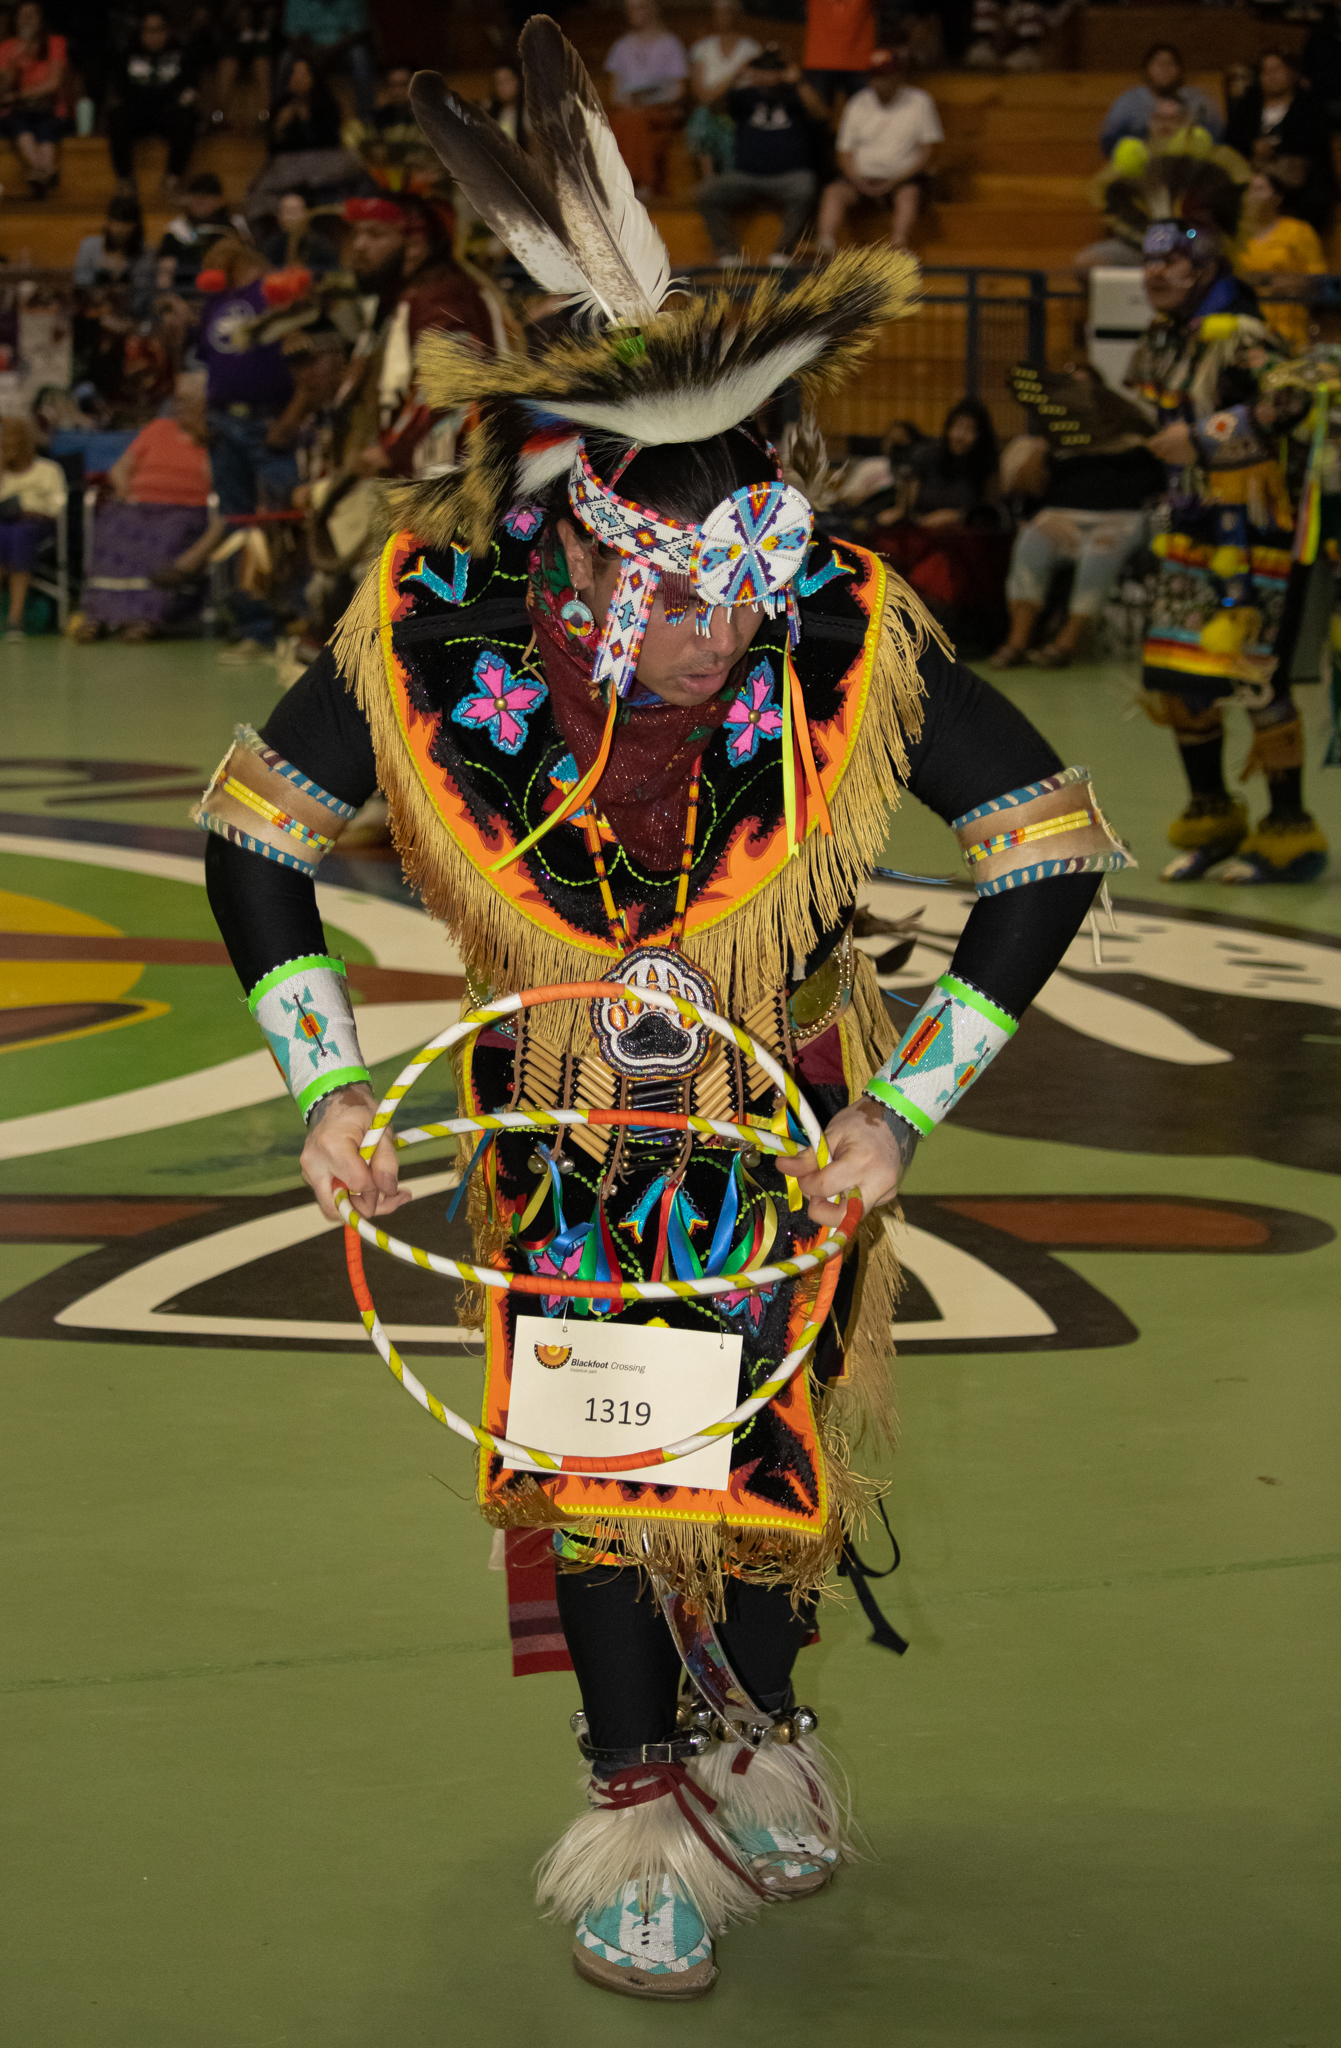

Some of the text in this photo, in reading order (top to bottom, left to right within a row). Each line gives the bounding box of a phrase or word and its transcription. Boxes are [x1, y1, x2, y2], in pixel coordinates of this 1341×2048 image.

[571, 1358, 646, 1374] Blackfoot Crossing
[585, 1397, 651, 1426] 1319
